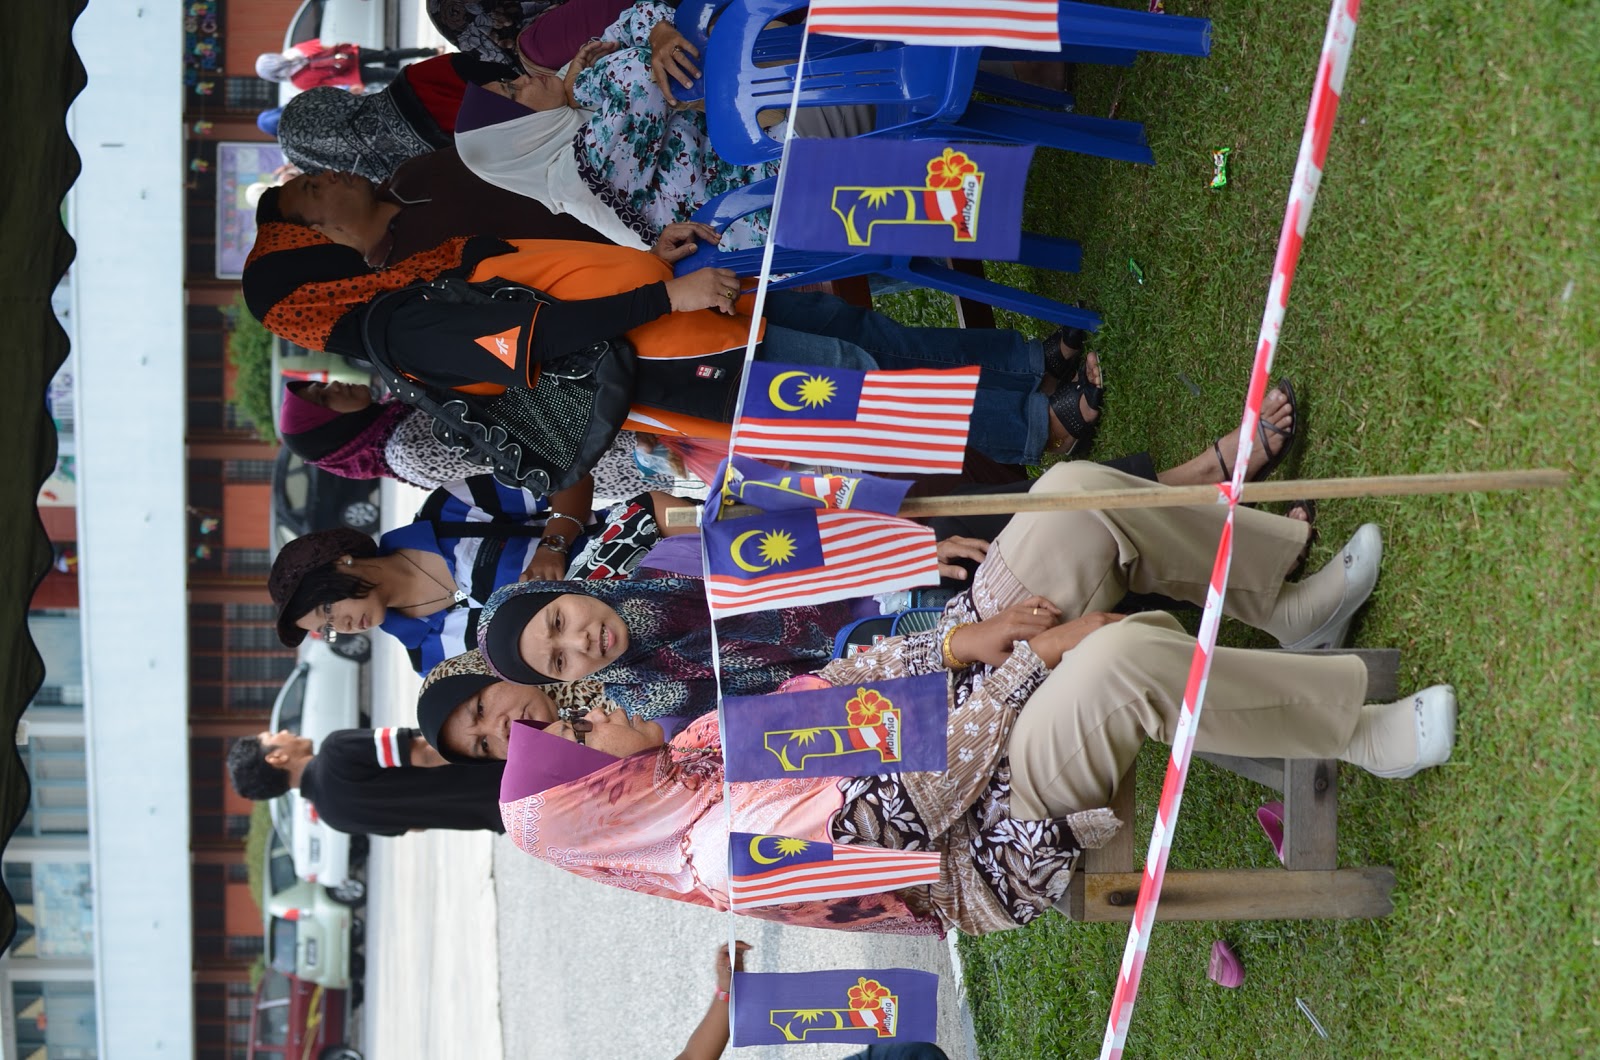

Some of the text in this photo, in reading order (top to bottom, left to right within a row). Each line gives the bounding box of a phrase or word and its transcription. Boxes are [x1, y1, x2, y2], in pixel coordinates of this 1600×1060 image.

[960, 181, 976, 233] Malaysia
[883, 717, 897, 756] Malaysia
[882, 1002, 894, 1033] Malaysia
